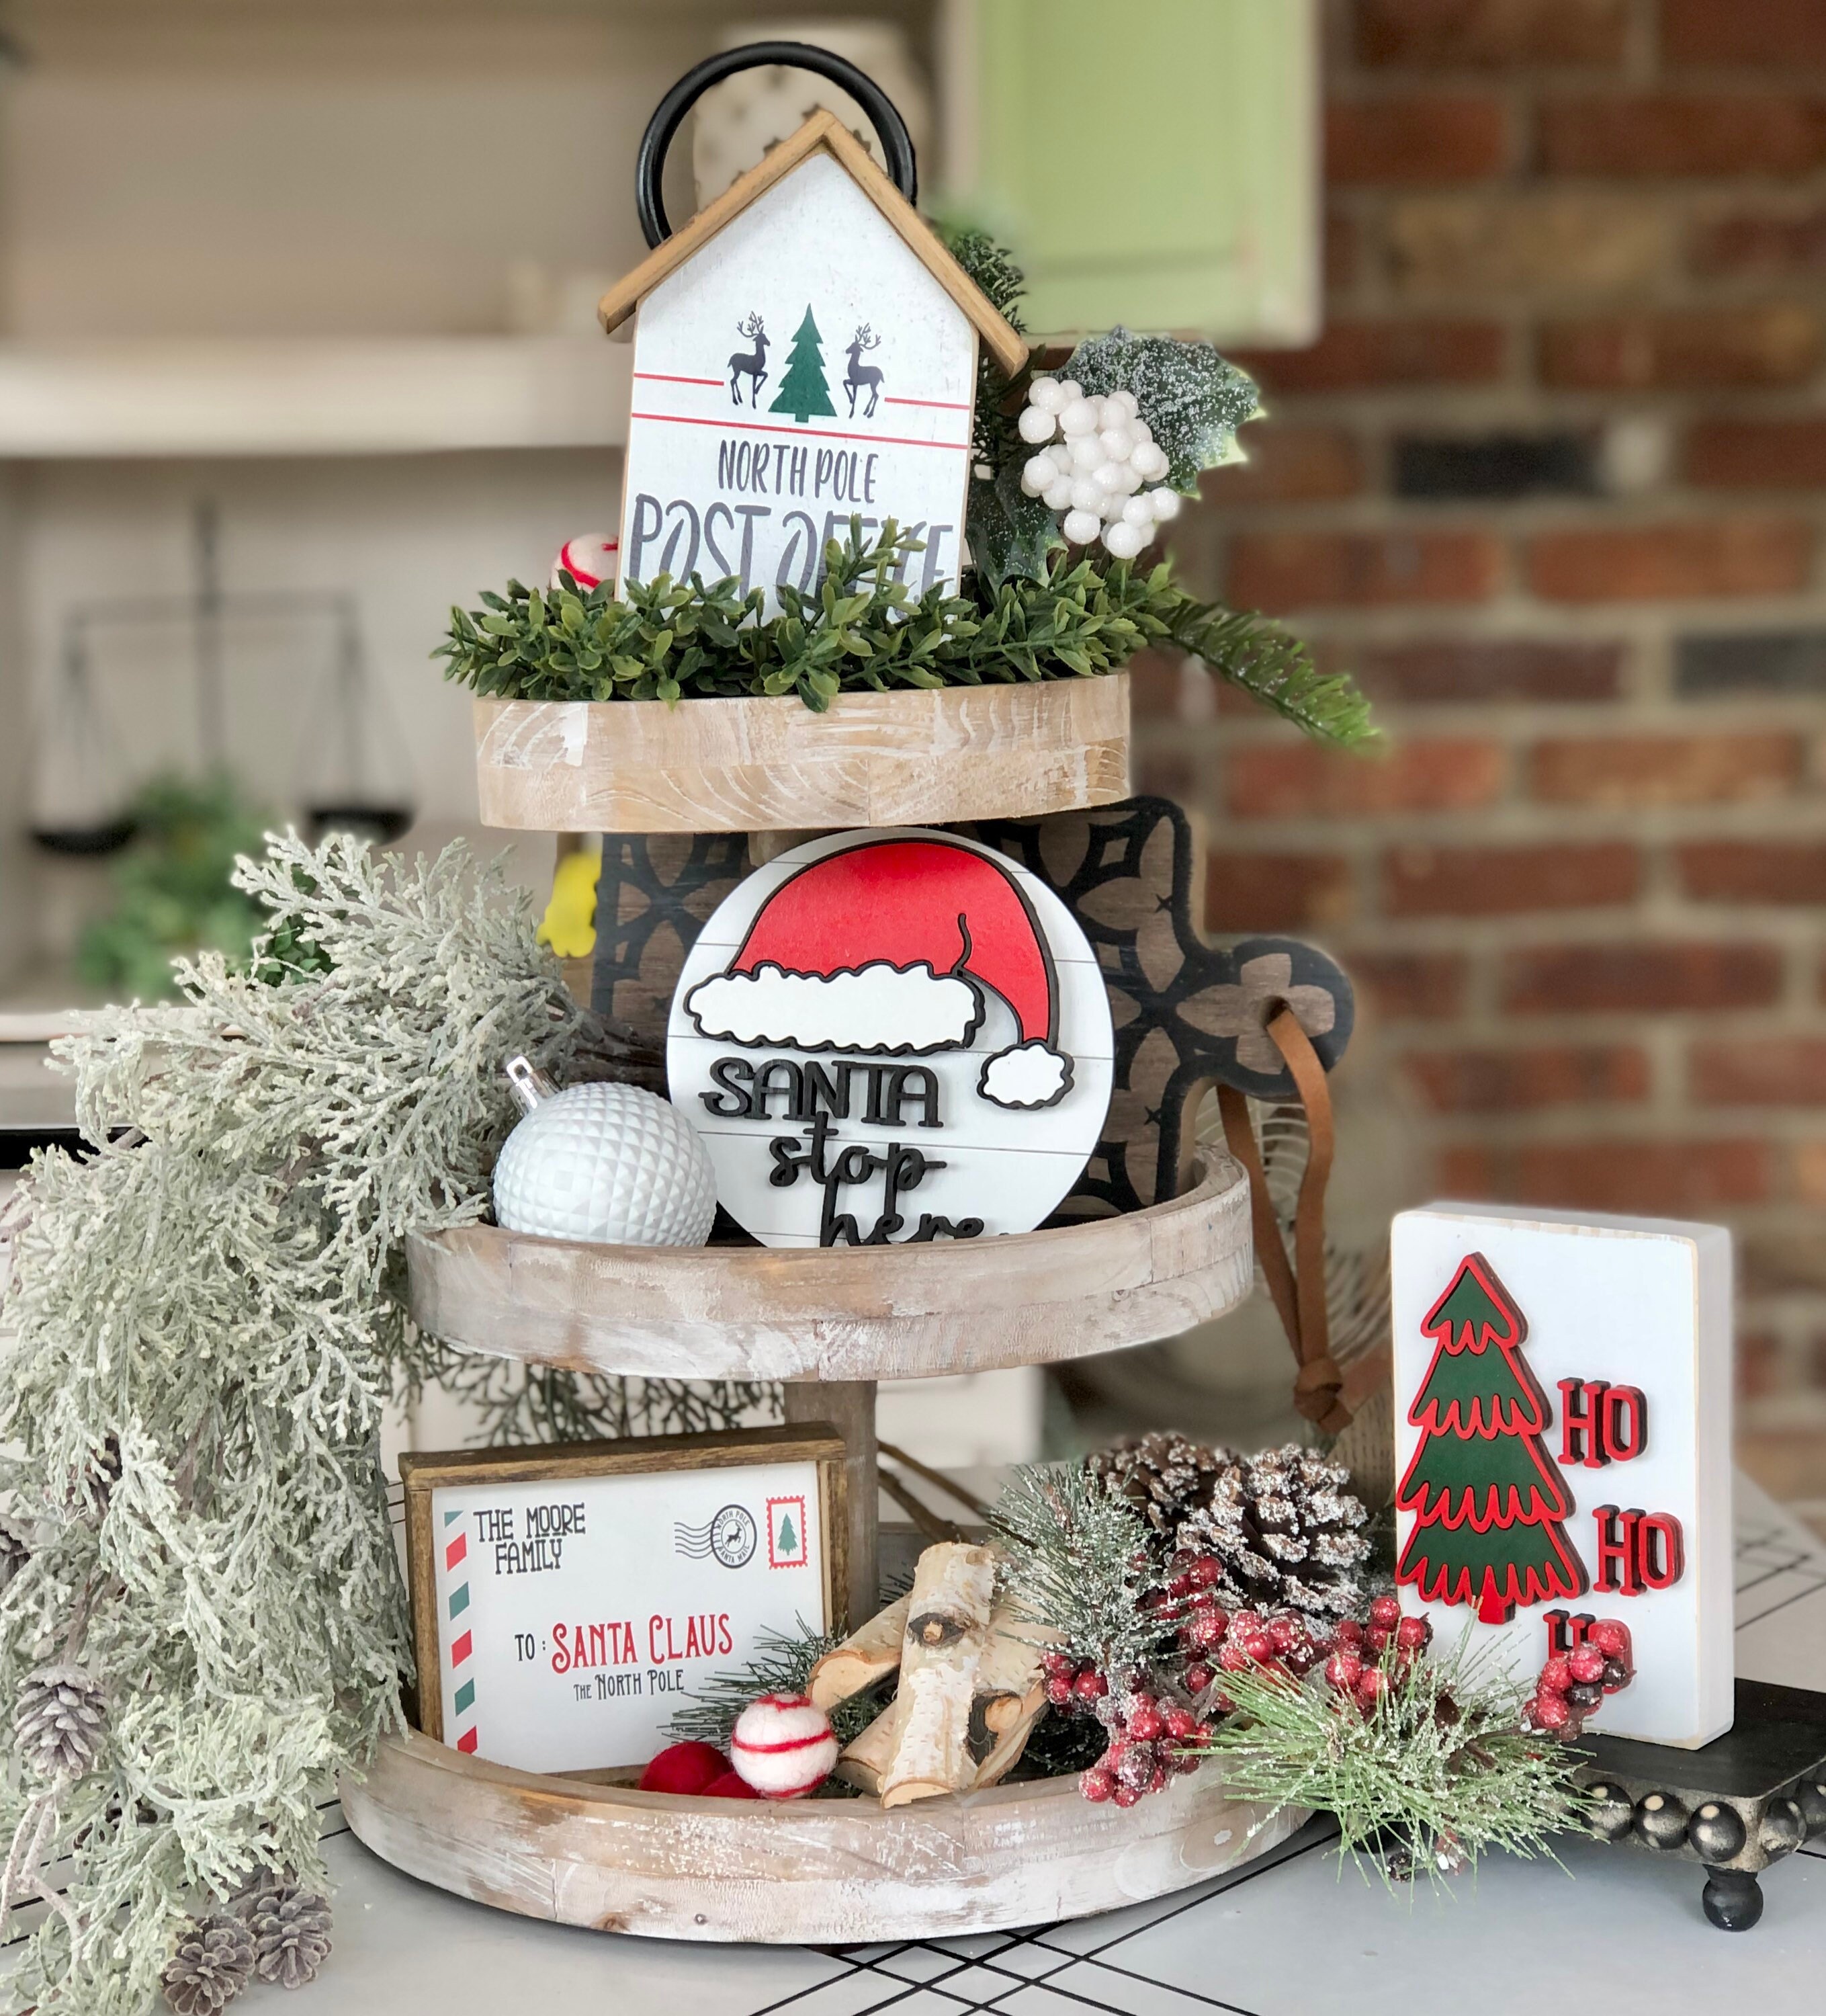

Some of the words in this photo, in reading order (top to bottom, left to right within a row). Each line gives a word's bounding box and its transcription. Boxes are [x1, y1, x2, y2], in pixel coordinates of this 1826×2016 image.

[718, 439, 808, 497] NORTH
[814, 448, 879, 503] POLE
[628, 493, 772, 601] POST
[697, 1056, 944, 1128] SANTA
[768, 1111, 947, 1214] stop
[1556, 1376, 1649, 1468] HO
[472, 1507, 514, 1544] THE
[526, 1502, 586, 1540] MOORE
[736, 1510, 750, 1526] POLE
[494, 1537, 564, 1574] FAMILY
[737, 1545, 750, 1562] MAIL
[1591, 1505, 1687, 1597] HO
[550, 1621, 639, 1675] SANTA
[648, 1613, 734, 1665] CLAUS
[573, 1683, 593, 1702] THE
[595, 1673, 642, 1700] NORTH
[647, 1669, 685, 1695] POLE
